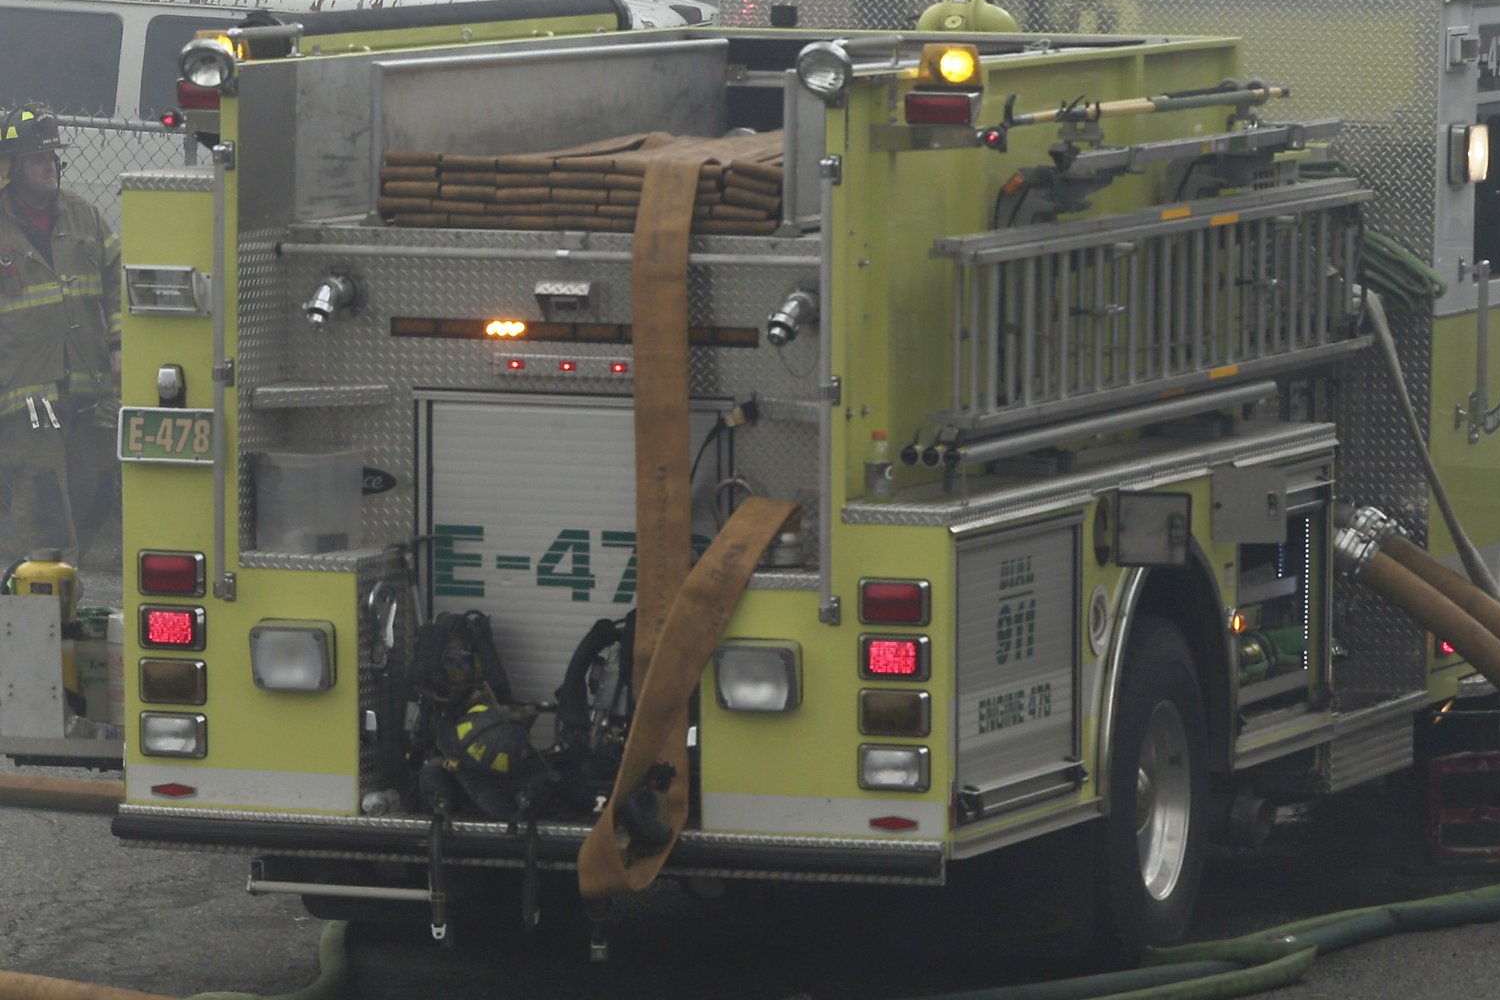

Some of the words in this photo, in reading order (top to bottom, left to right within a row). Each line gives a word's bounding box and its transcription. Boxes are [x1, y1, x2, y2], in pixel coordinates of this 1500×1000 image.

[128, 416, 211, 453] E-478
[434, 524, 714, 604] E-47
[998, 554, 1034, 591] DIAL
[995, 599, 1037, 666] 911
[978, 688, 1025, 735] ENGINE
[1027, 682, 1052, 717] 478
